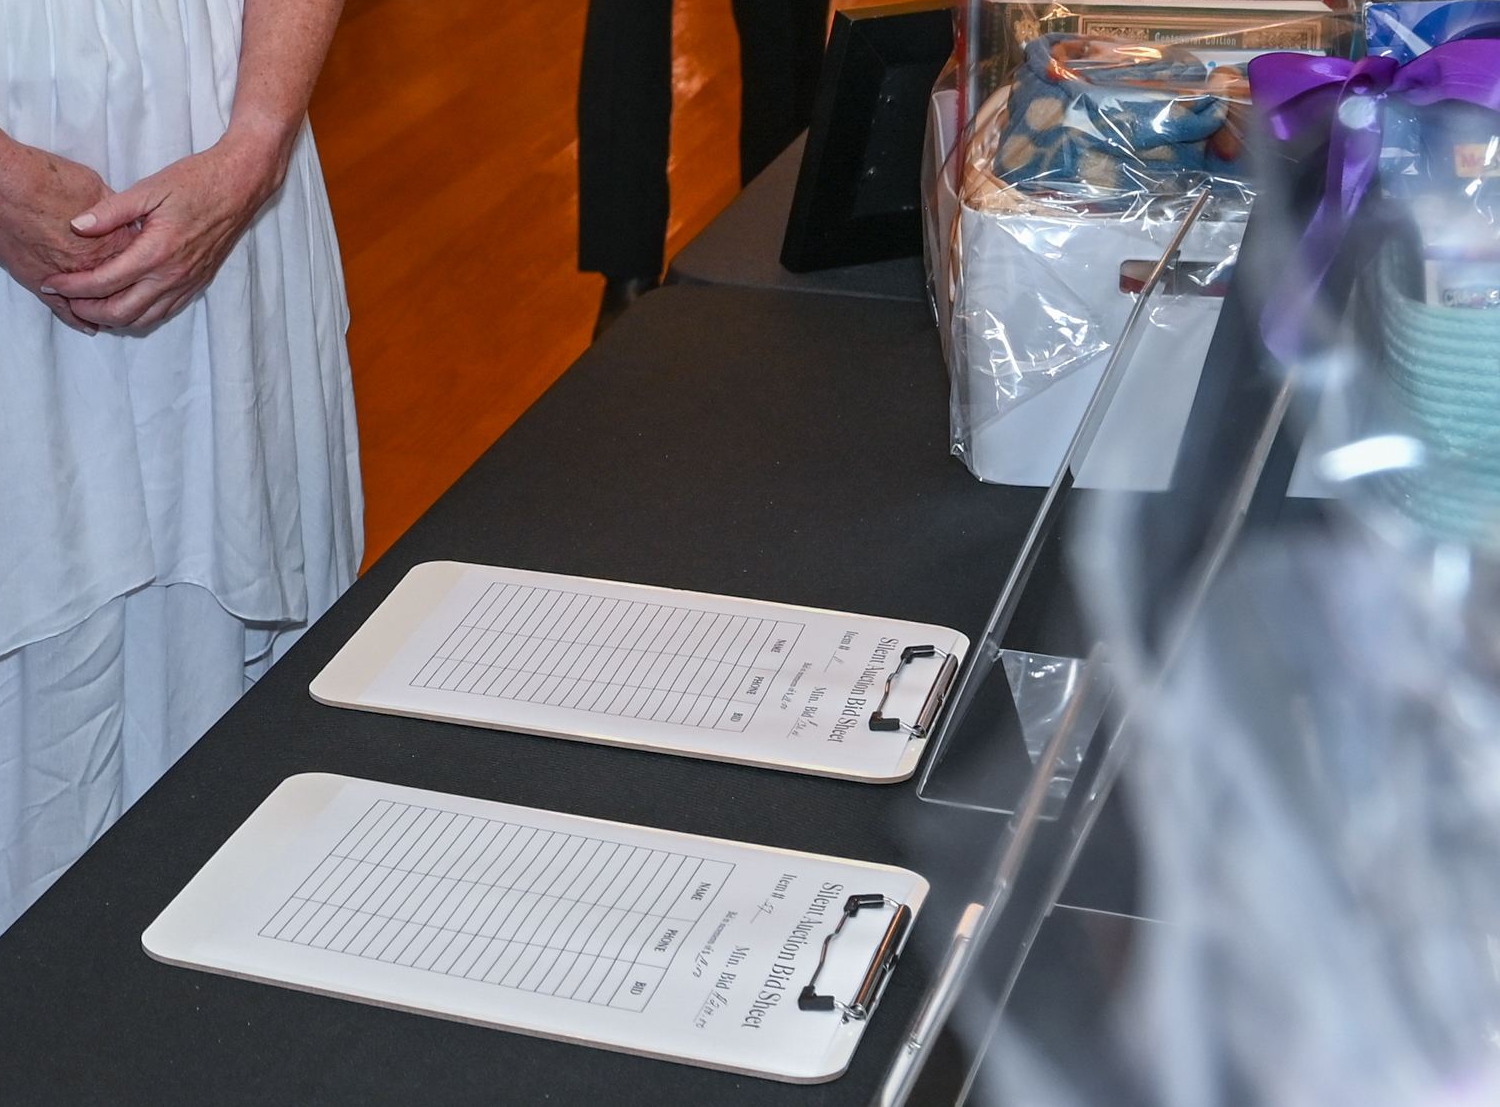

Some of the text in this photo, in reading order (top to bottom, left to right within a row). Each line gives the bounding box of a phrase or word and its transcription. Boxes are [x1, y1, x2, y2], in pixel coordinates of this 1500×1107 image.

[746, 675, 765, 695] PHONE
[827, 637, 899, 743] Silent Auction Bid Sheet
[730, 712, 744, 723] BID
[801, 706, 818, 718] Bid
[690, 881, 712, 901] NAME
[774, 873, 797, 893] Item
[653, 928, 679, 953] PHONE
[725, 945, 750, 968] Min.
[741, 882, 844, 1029] Silent Auction Bid Sheet
[629, 980, 647, 996] BID
[715, 971, 737, 990] Bid
